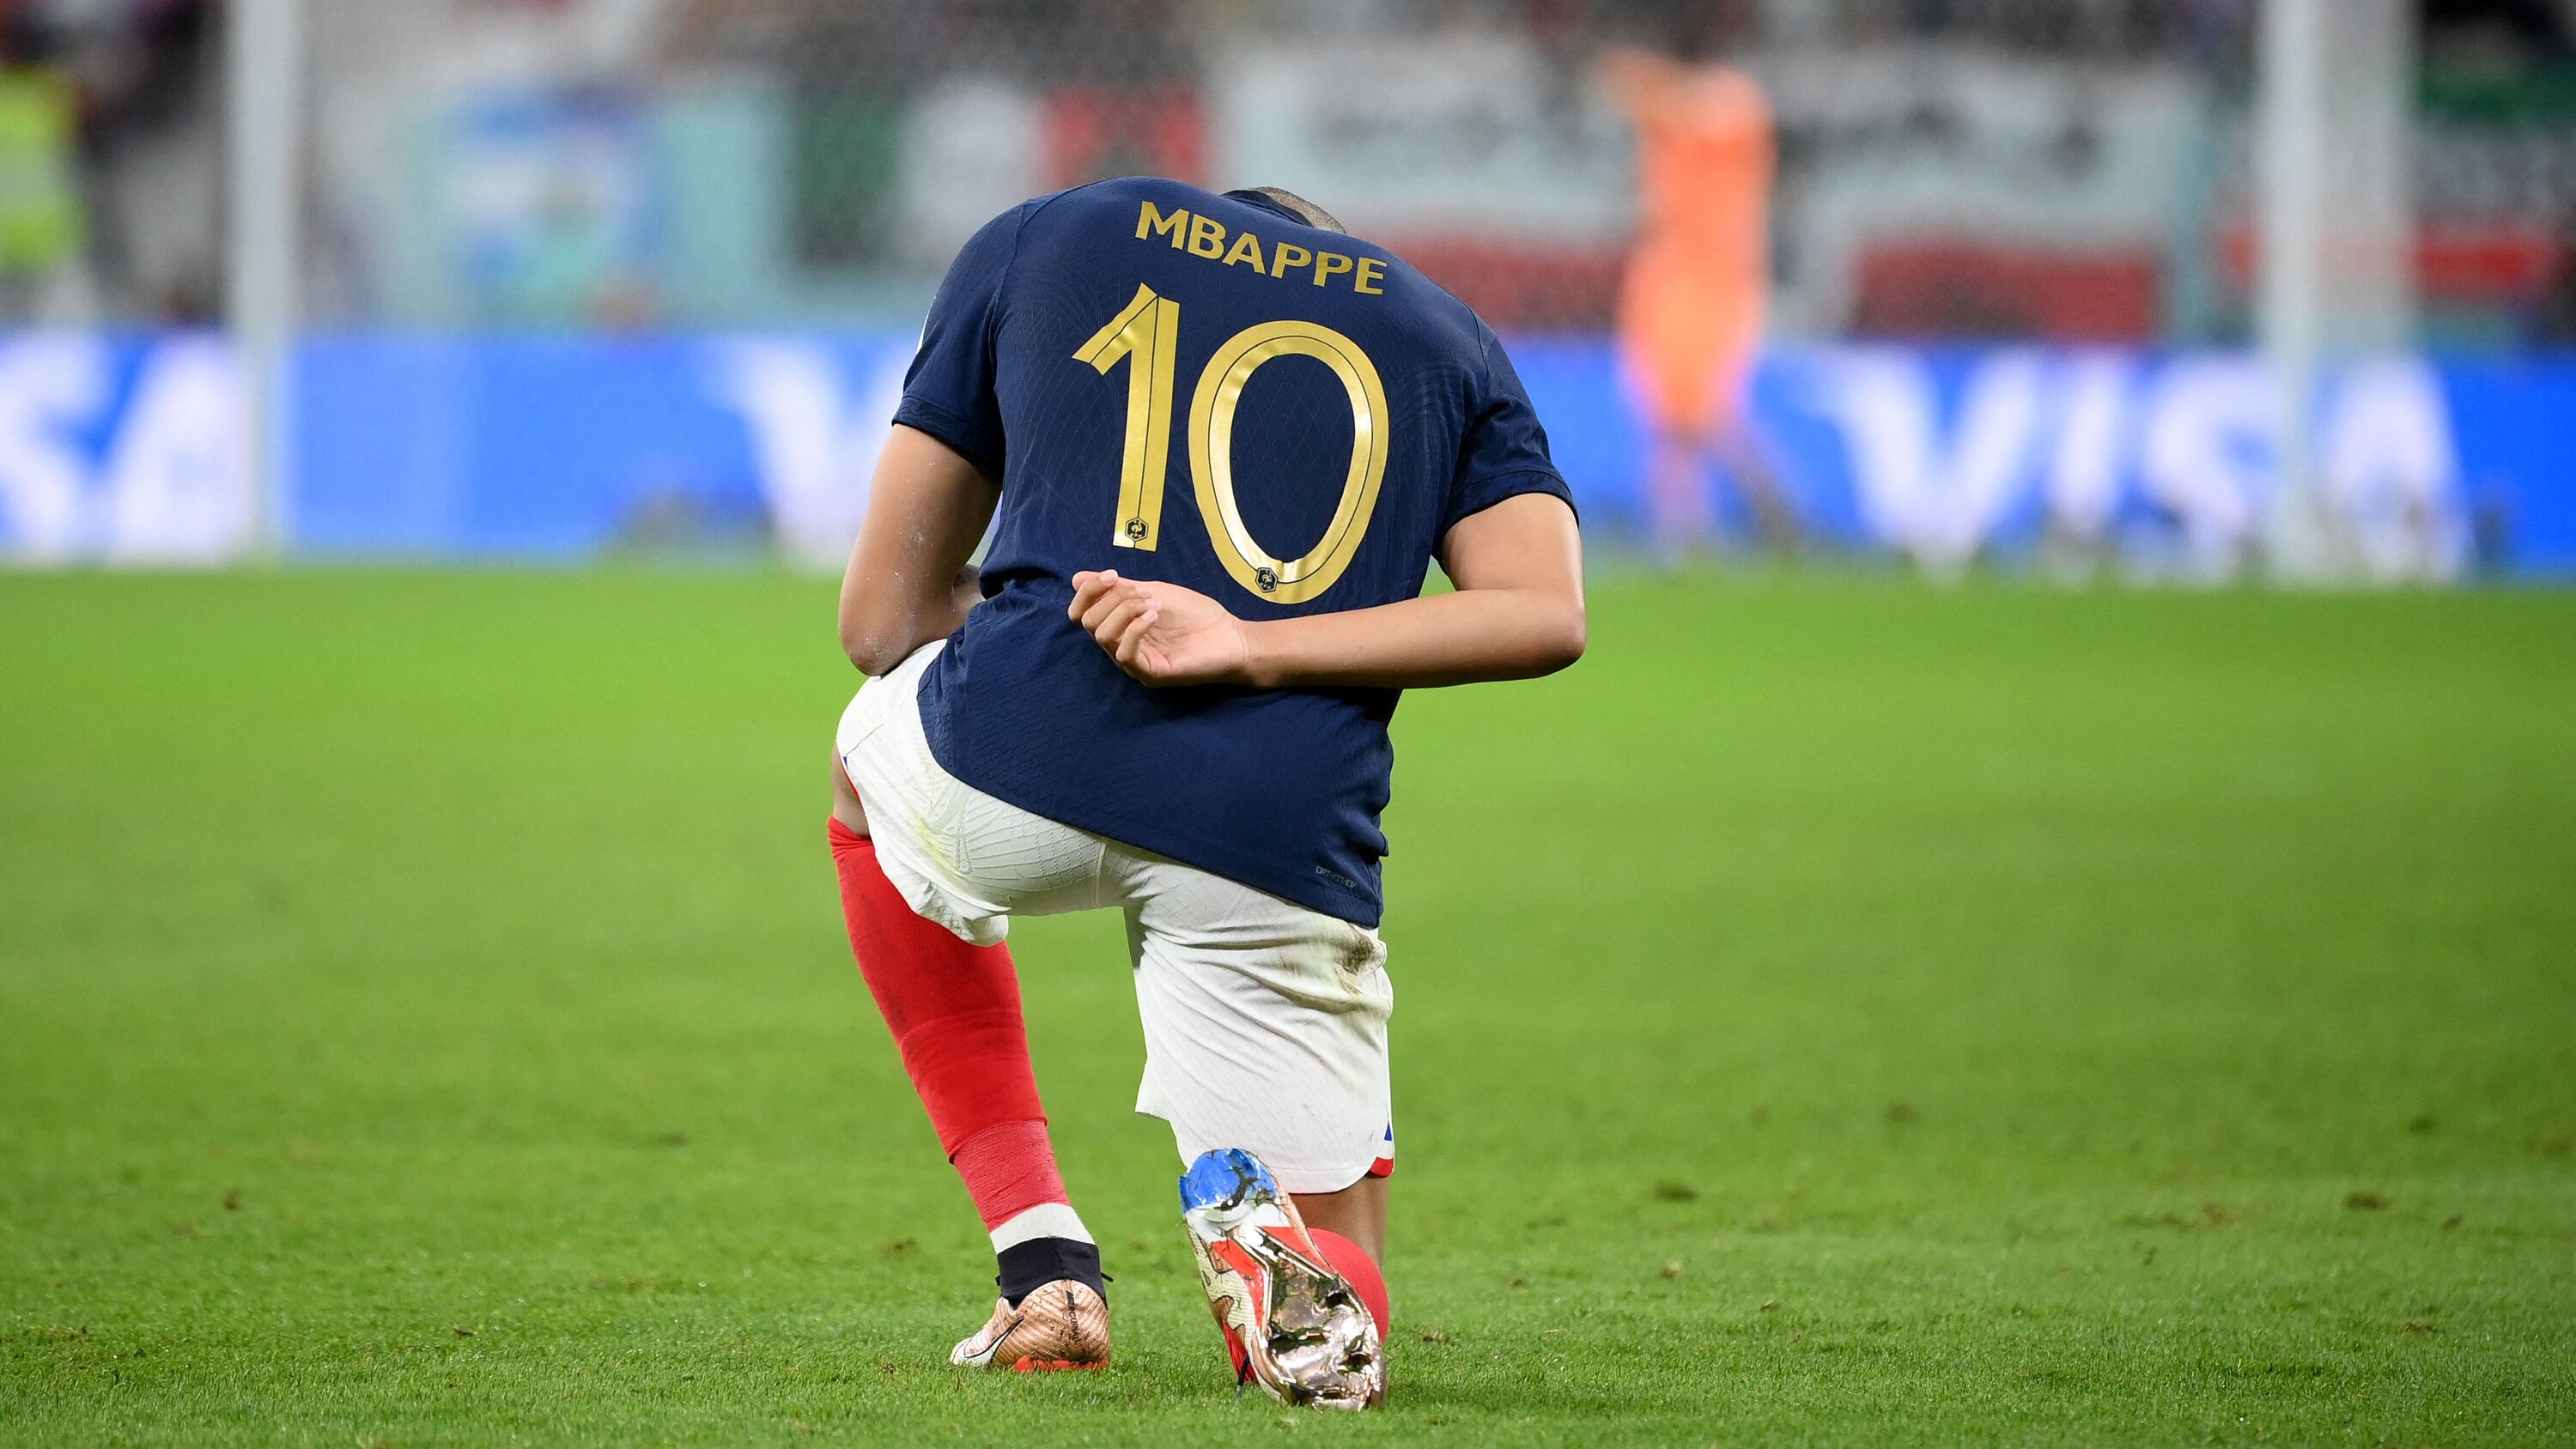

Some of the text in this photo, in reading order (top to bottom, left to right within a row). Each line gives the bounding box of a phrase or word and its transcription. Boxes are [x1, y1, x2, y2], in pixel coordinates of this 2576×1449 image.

[1134, 200, 1388, 294] MBAPPE
[1072, 282, 1389, 604] 10
[1807, 347, 2475, 585] VISA
